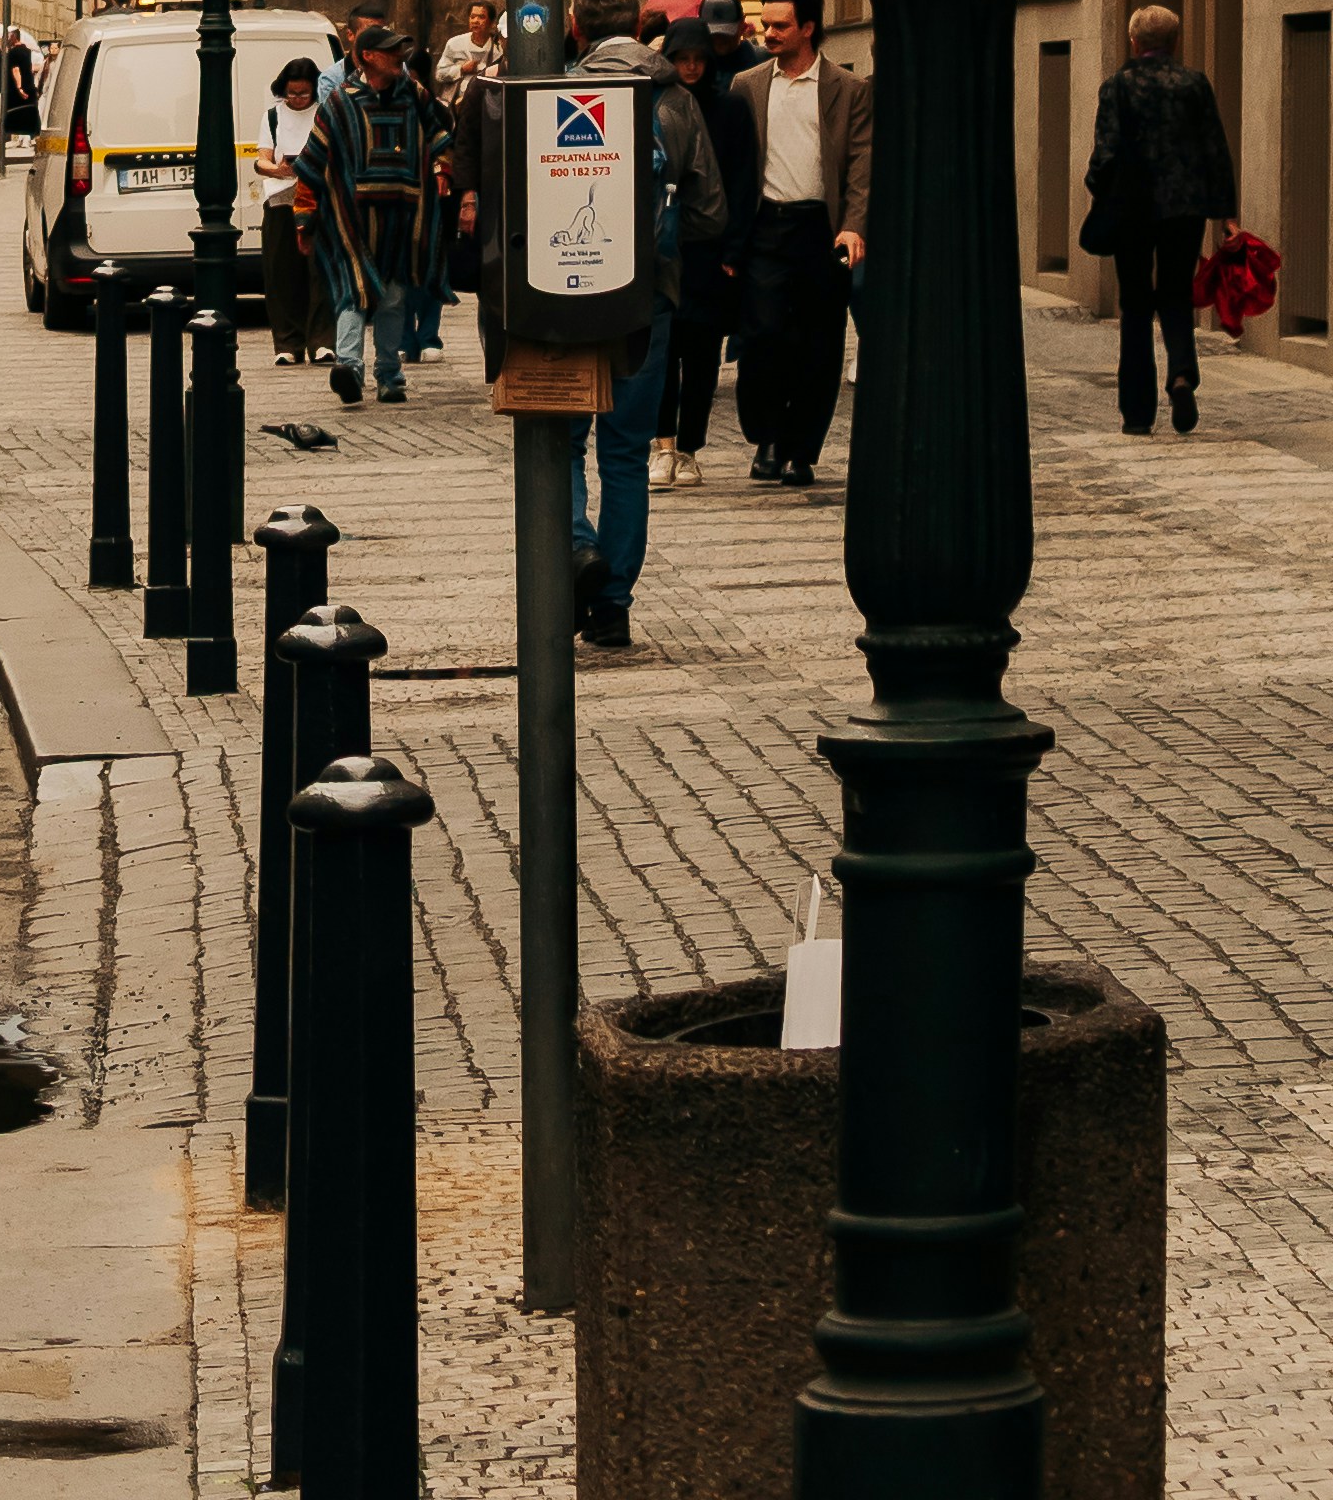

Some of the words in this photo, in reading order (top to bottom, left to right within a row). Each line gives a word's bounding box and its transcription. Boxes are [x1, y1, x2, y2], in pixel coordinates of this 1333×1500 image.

[564, 133, 593, 142] PRAHA
[540, 152, 592, 163] BEZPLATNÁ
[594, 152, 621, 162] LINKA
[550, 168, 569, 178] 800
